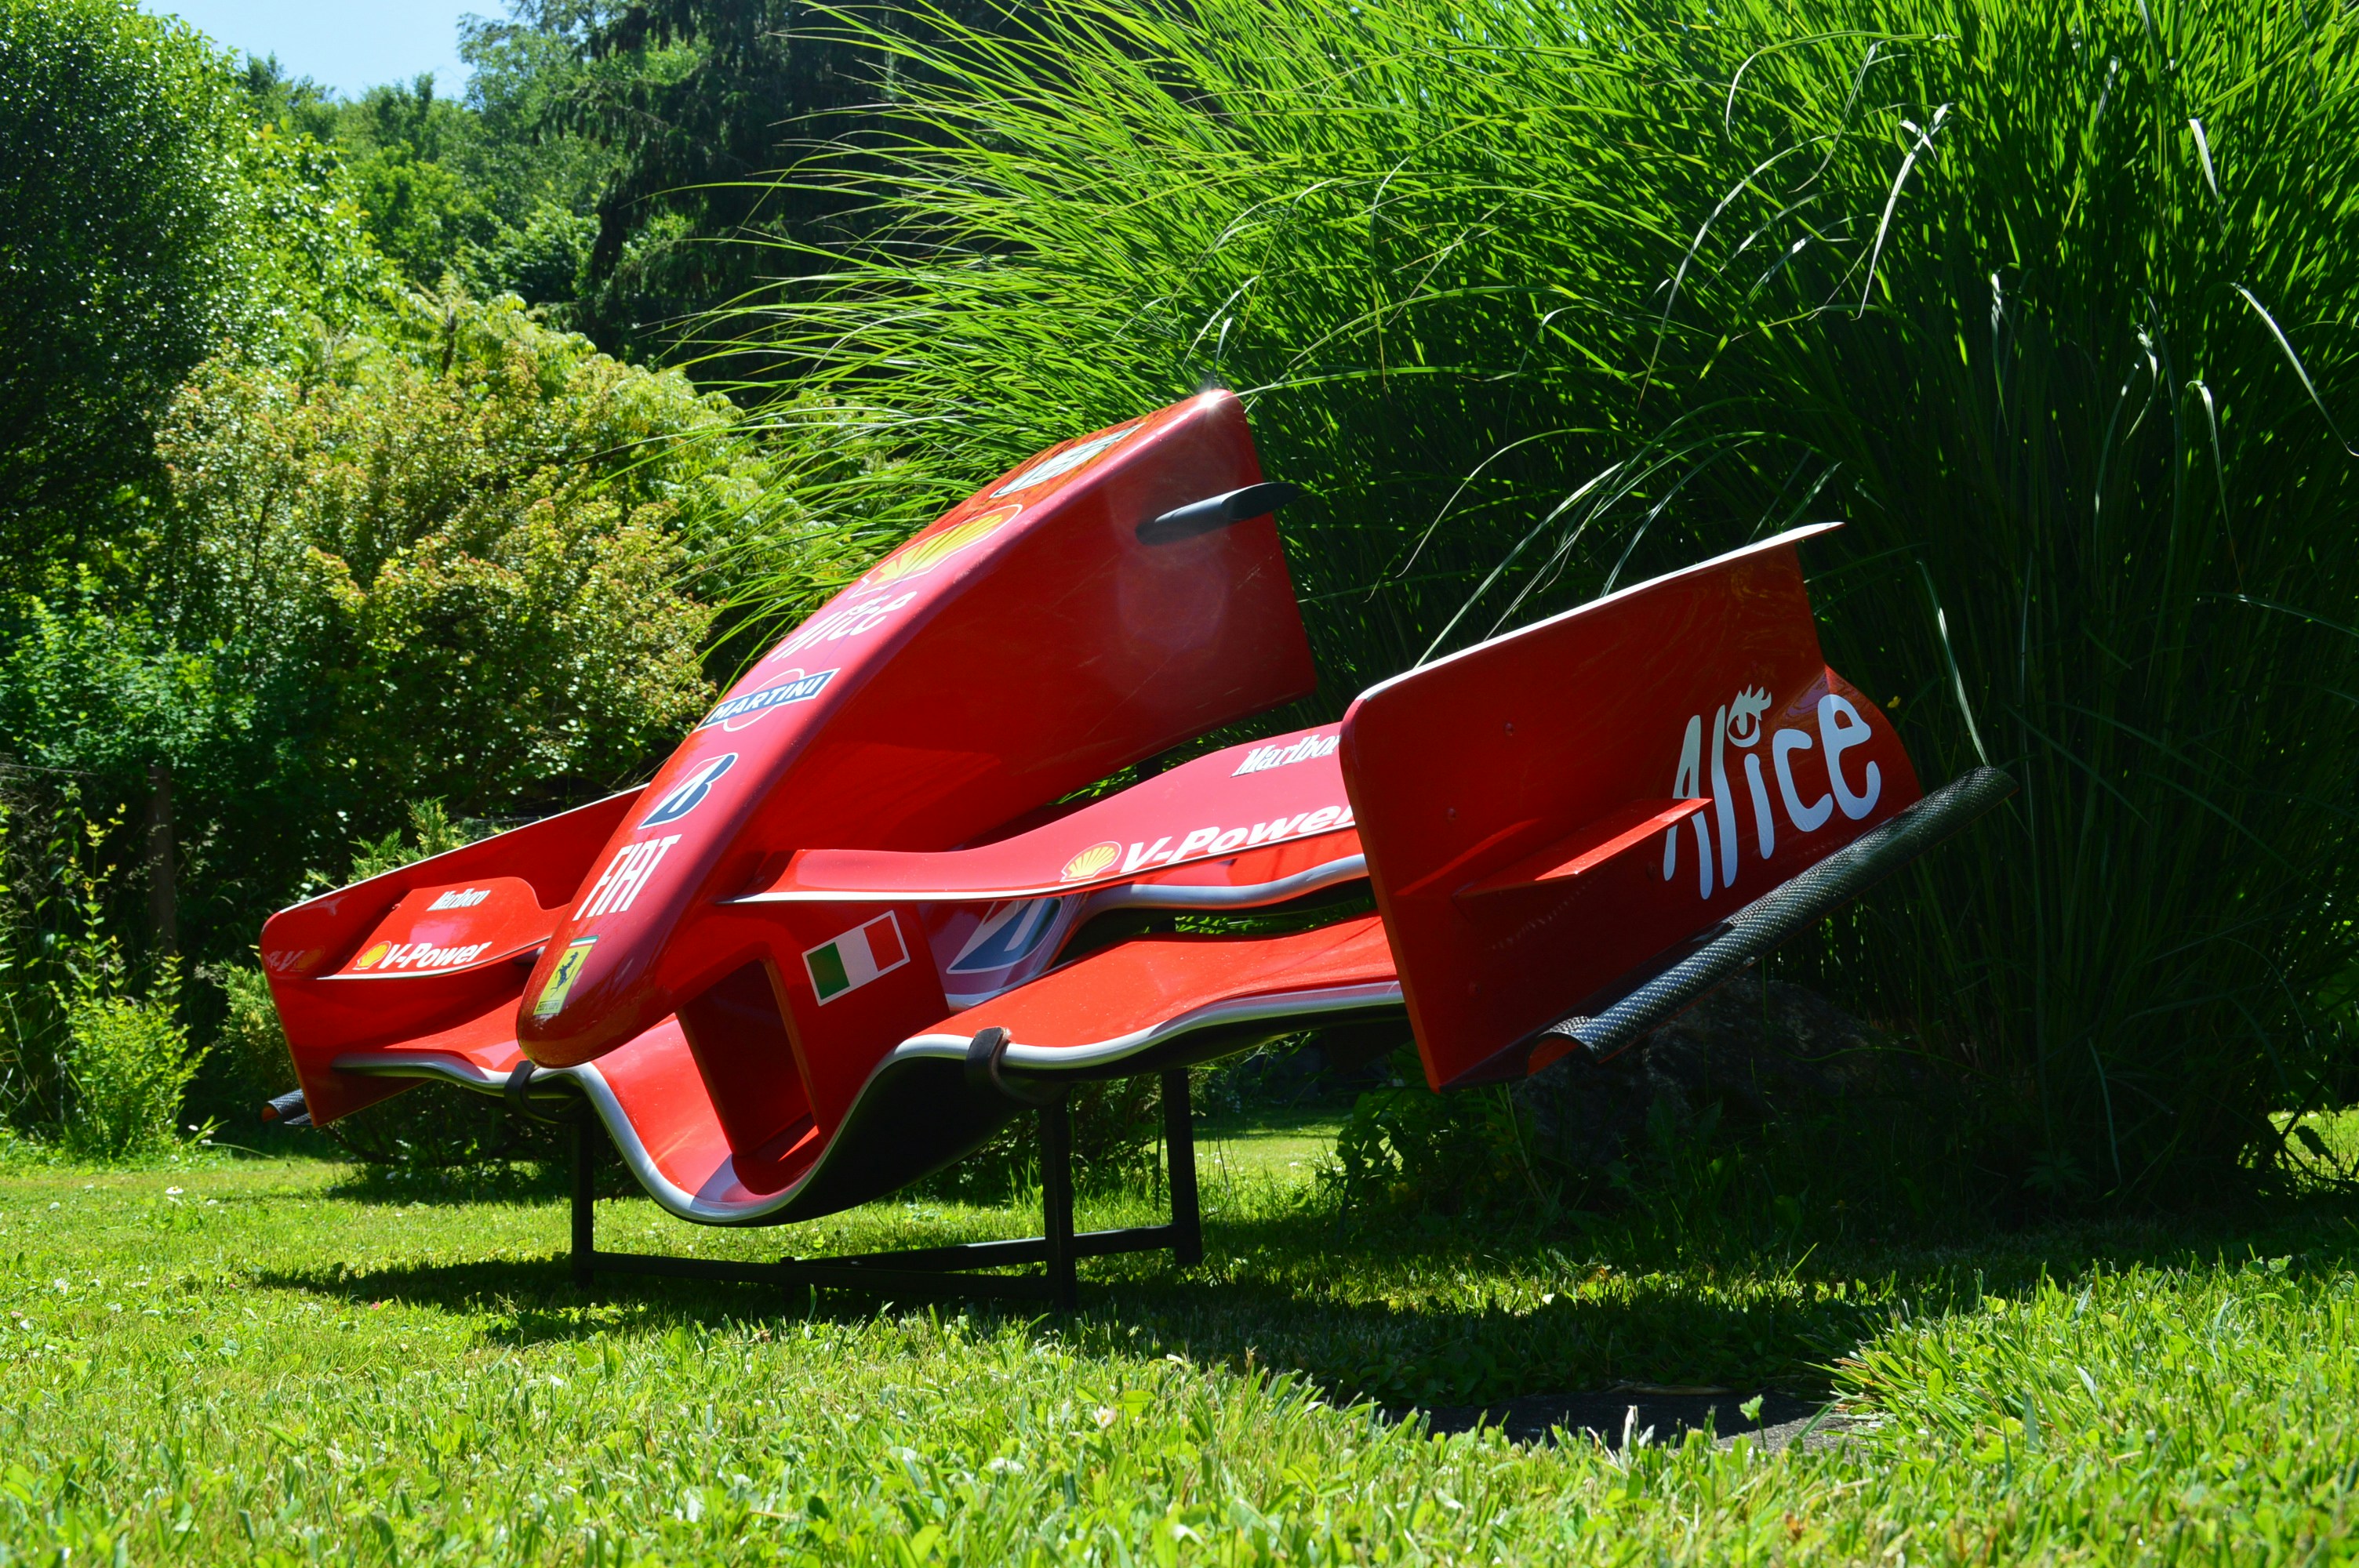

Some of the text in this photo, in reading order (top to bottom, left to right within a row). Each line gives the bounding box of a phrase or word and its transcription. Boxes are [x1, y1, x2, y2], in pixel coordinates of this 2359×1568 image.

[767, 590, 918, 662] Alice
[705, 676, 826, 720] MARTINI
[1230, 734, 1341, 779] Marlbor
[1663, 684, 1881, 901] Alice
[426, 887, 492, 912] Marlboro
[572, 833, 682, 921] FIAT
[379, 941, 493, 970] V-Power
